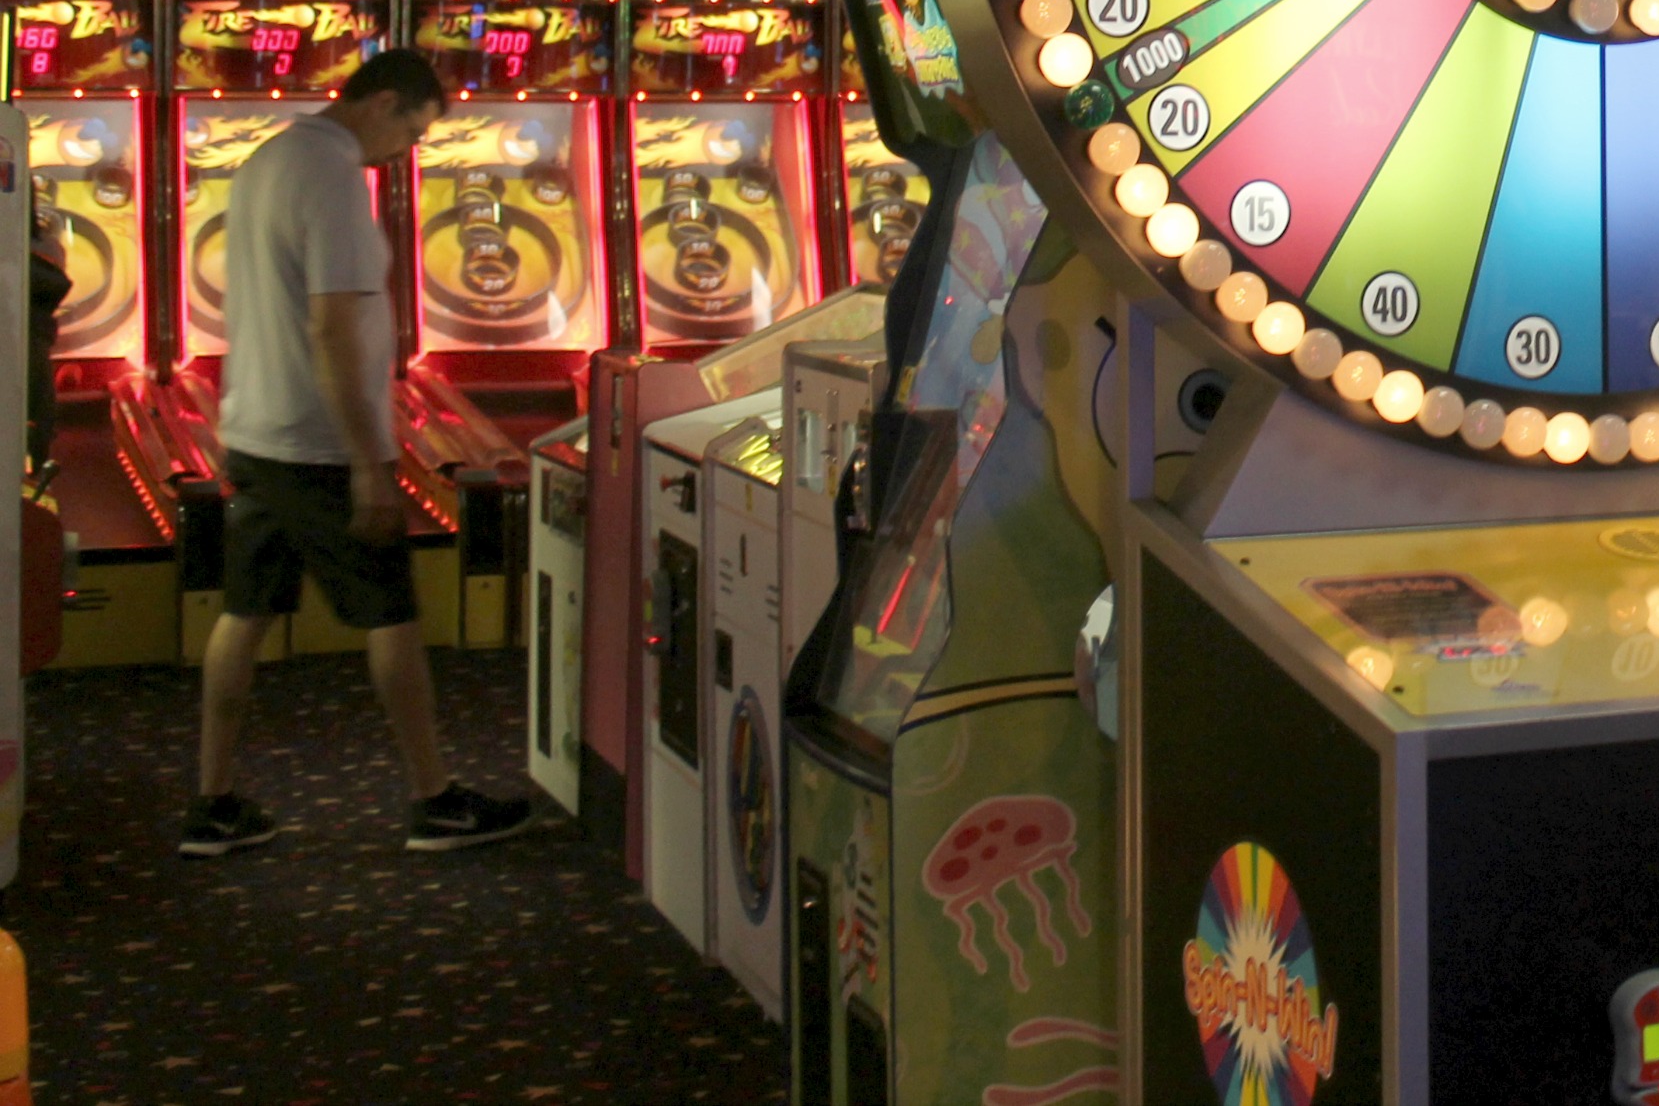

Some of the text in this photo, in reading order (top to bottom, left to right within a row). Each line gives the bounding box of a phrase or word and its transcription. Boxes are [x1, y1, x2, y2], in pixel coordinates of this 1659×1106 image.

[1122, 32, 1184, 84] 1000
[1160, 99, 1199, 137] 20
[1242, 195, 1275, 228] 15
[1371, 285, 1408, 324] 40
[1515, 329, 1551, 366] 30
